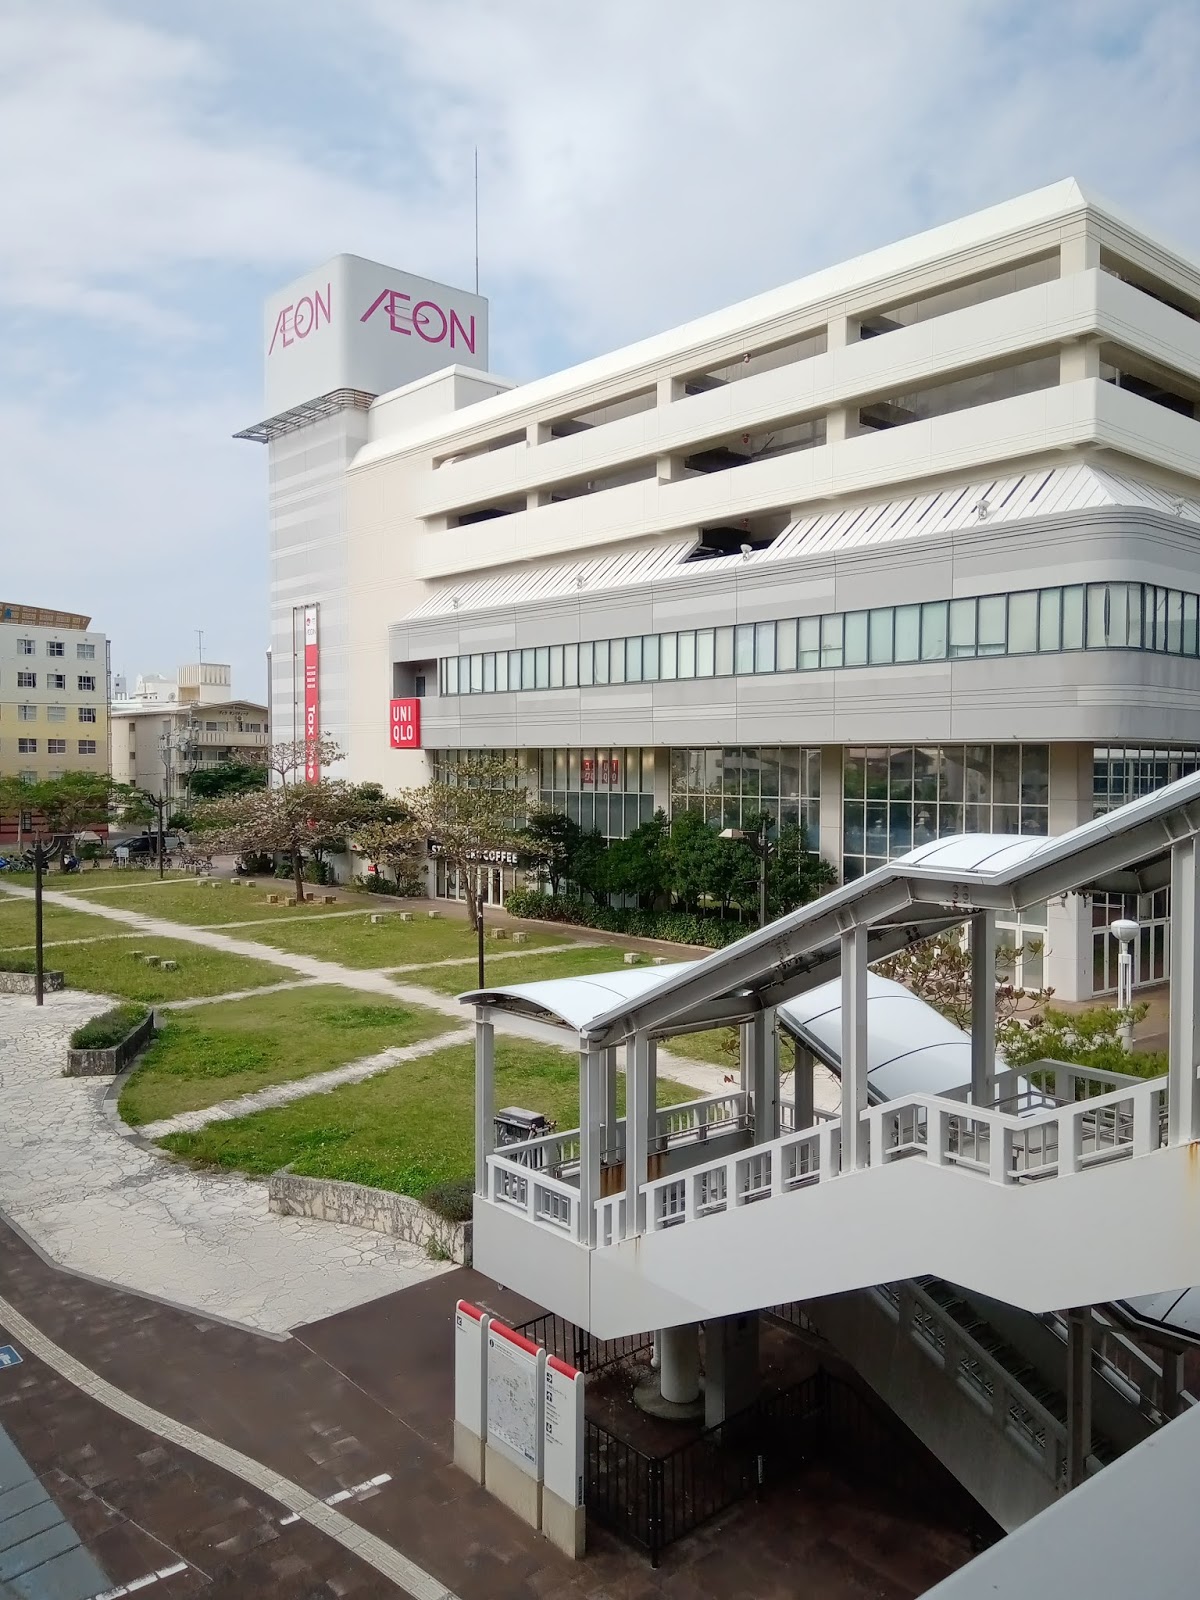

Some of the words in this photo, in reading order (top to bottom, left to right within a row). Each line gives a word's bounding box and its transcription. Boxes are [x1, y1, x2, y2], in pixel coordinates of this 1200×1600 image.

[307, 704, 316, 736] Tax
[393, 705, 412, 722] UNI
[393, 724, 413, 744] QLO
[483, 849, 518, 864] COFFEE
